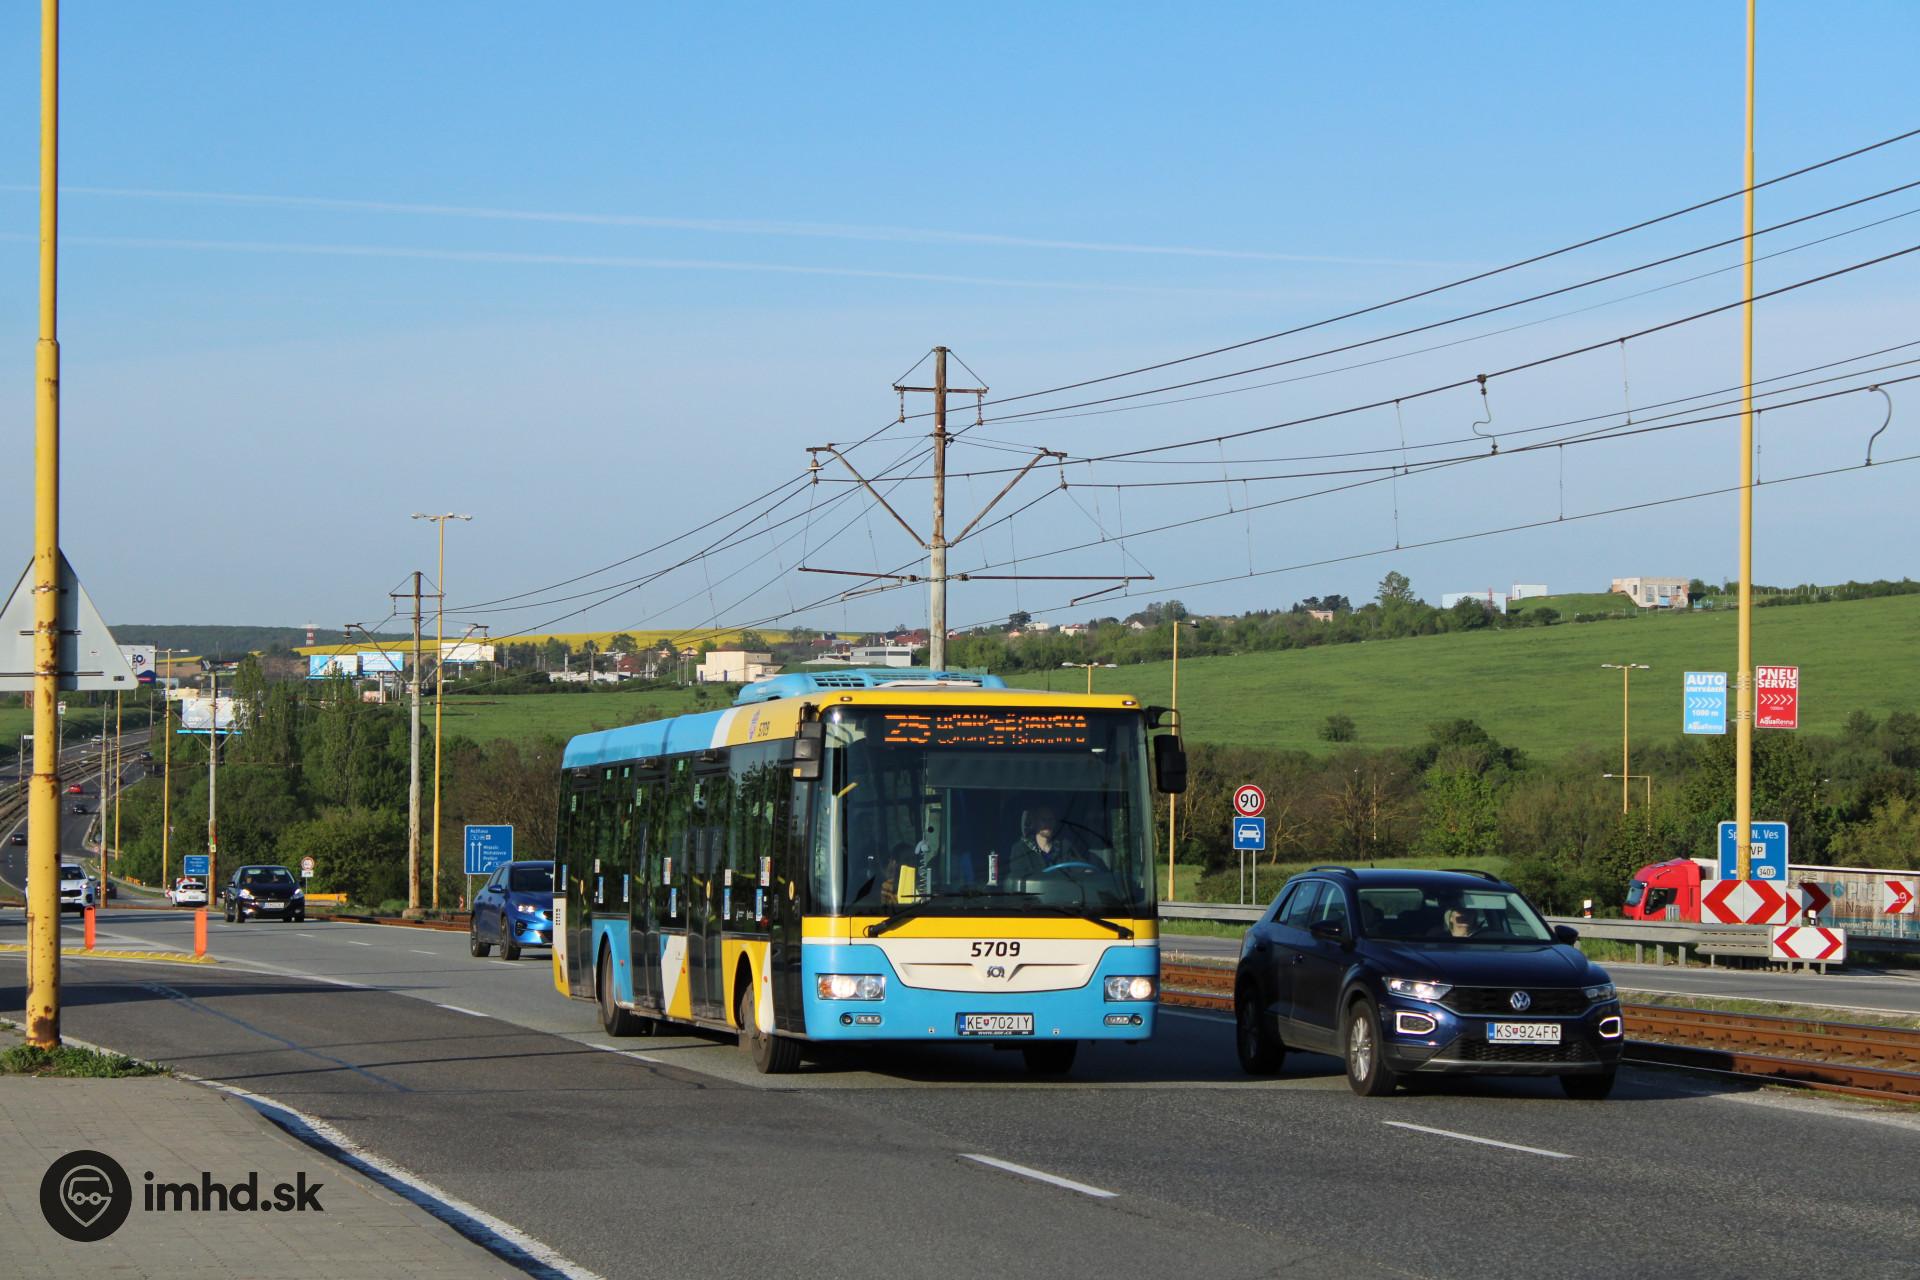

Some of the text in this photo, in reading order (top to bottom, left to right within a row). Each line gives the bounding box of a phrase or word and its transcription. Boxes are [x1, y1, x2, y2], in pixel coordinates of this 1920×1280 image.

[1758, 668, 1797, 680] PNEU
[1687, 675, 1725, 686] AUTO
[1758, 679, 1797, 688] SERVIS
[1240, 793, 1259, 808] 90
[1763, 829, 1780, 840] Ves
[1750, 846, 1764, 856] VP
[1759, 868, 1775, 877] 3403
[970, 941, 1021, 957] 5709
[967, 1016, 983, 1030] KE
[1496, 1025, 1559, 1039] KS 924FR
